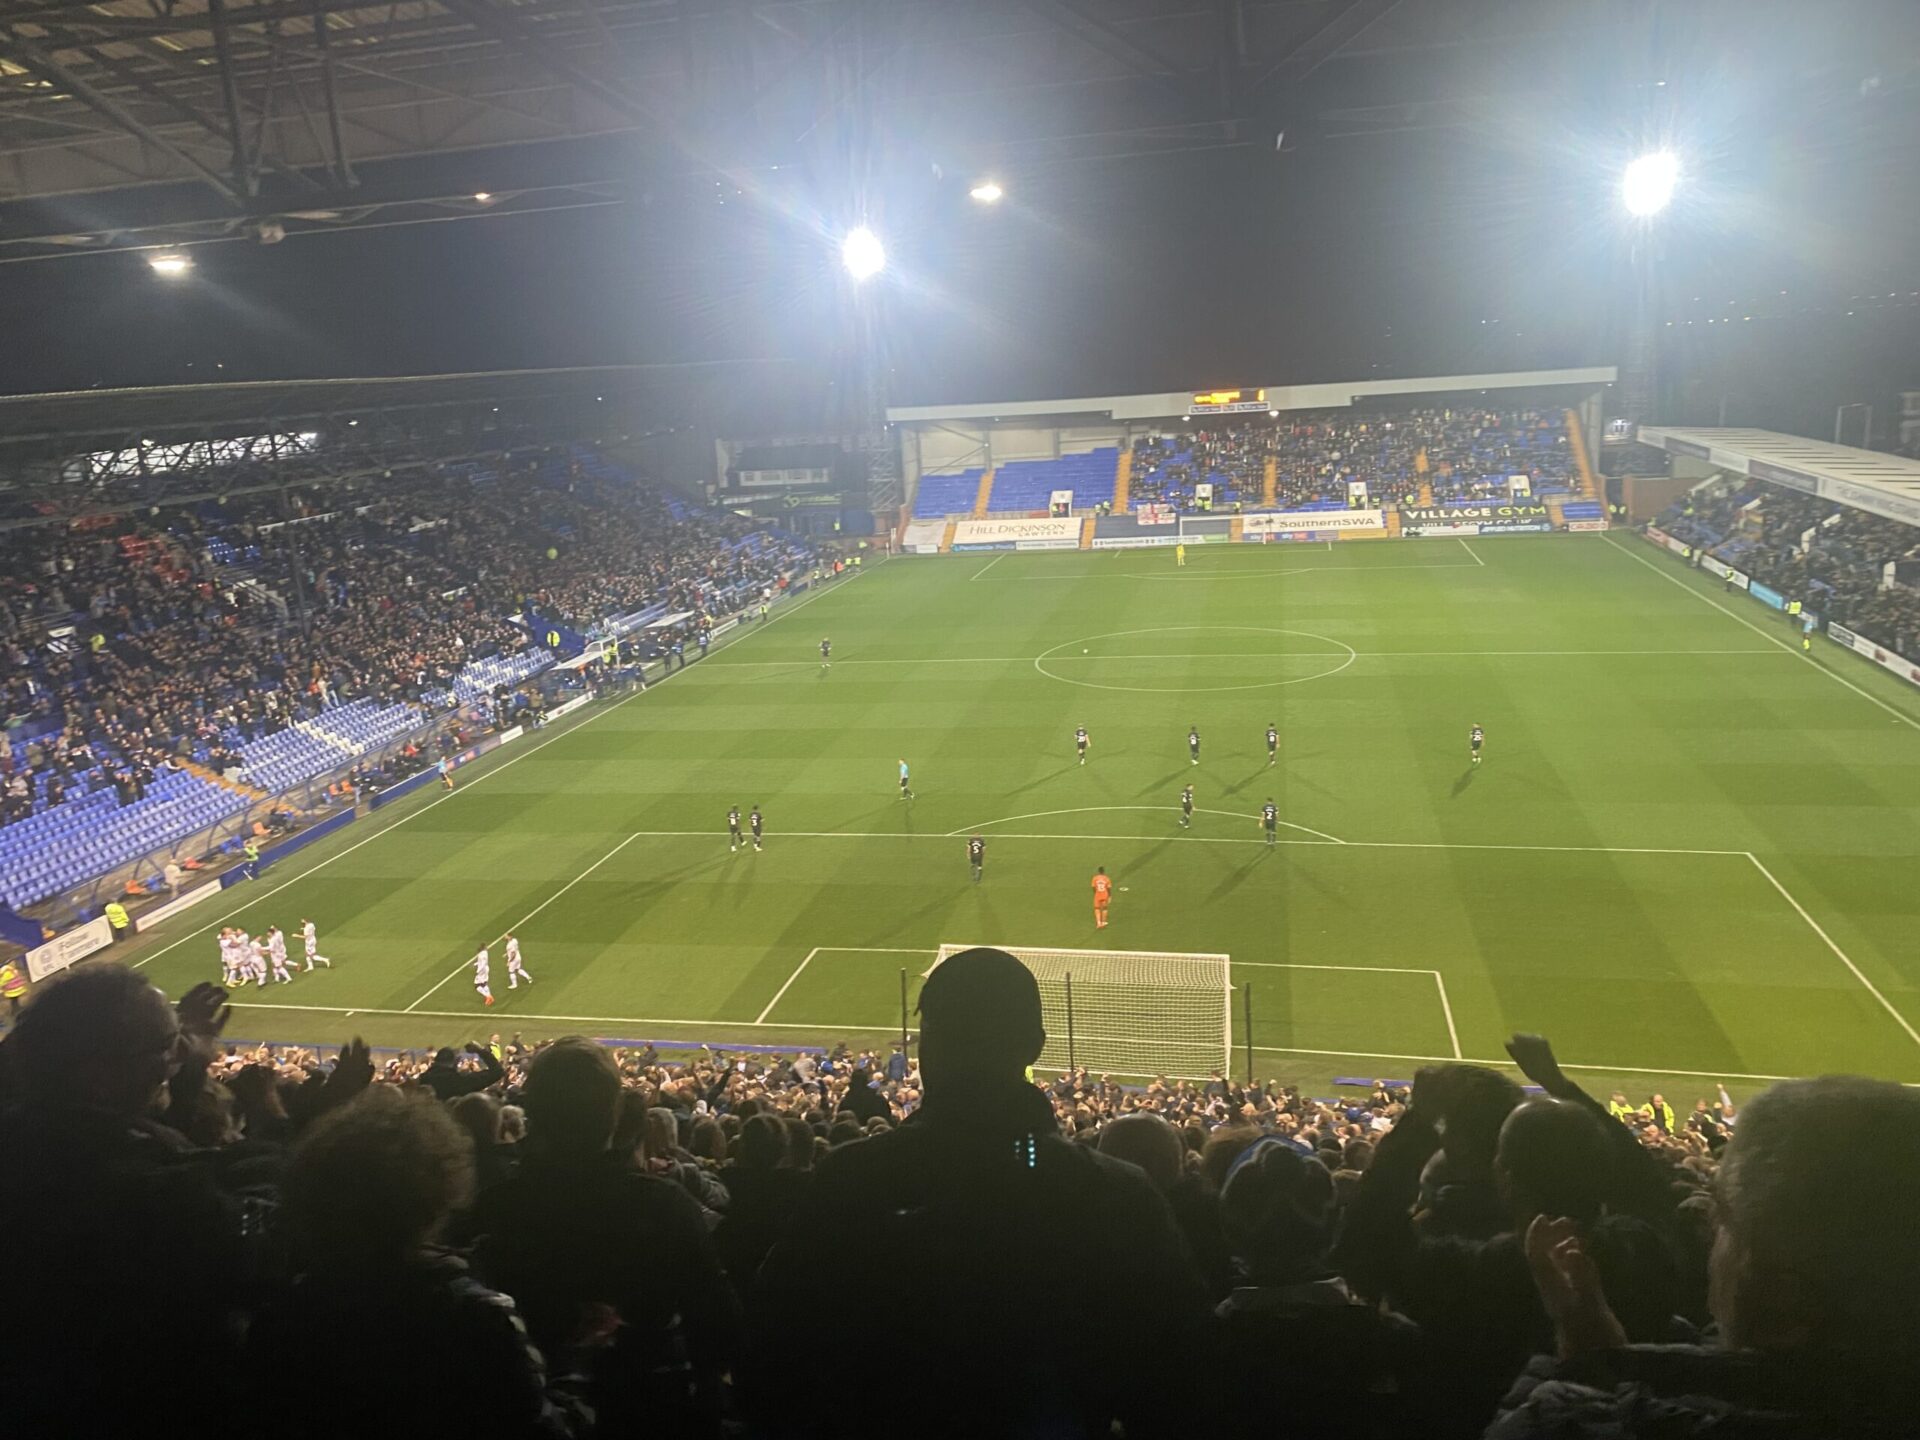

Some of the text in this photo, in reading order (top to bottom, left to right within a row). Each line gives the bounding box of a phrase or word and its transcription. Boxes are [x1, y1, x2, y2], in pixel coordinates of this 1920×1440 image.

[1405, 506, 1546, 519] VILLAGE GYM
[1280, 517, 1375, 528] SouthernSWA
[969, 524, 1066, 535] HILL DICKINSON
[1266, 811, 1273, 819] 2
[973, 845, 980, 854] 5
